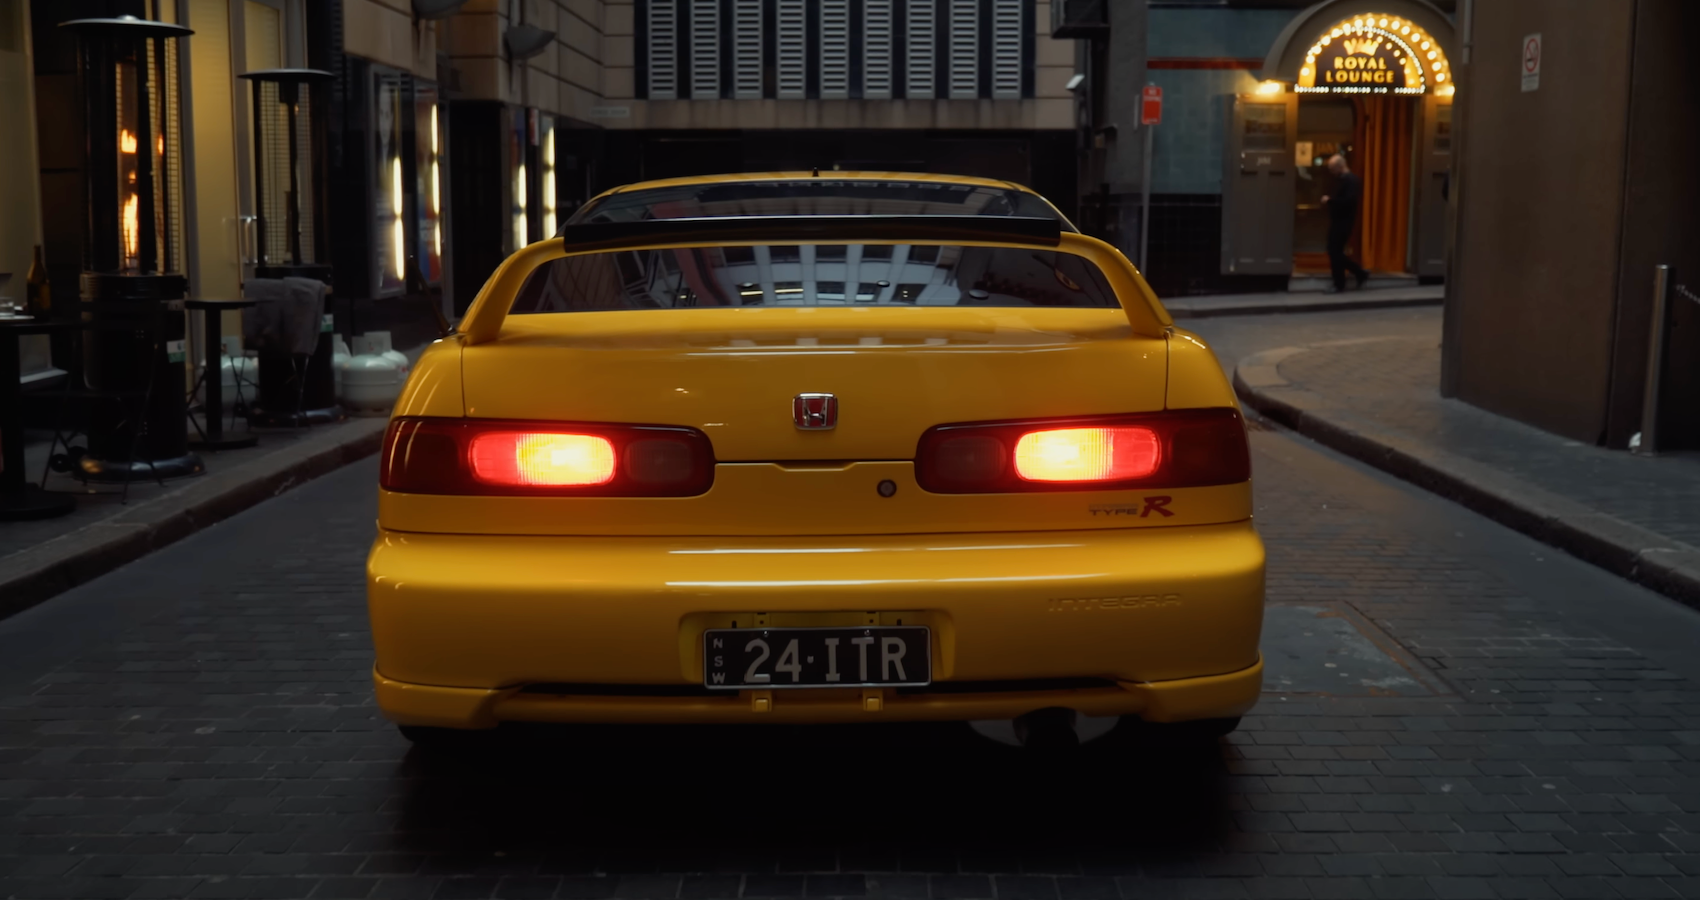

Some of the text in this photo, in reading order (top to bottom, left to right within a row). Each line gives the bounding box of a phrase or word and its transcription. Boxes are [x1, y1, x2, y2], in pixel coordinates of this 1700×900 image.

[1333, 56, 1387, 70] ROYAL
[1325, 70, 1395, 84] LOUNGE
[1088, 495, 1175, 518] TYPE R
[1048, 593, 1182, 612] INTEGRA
